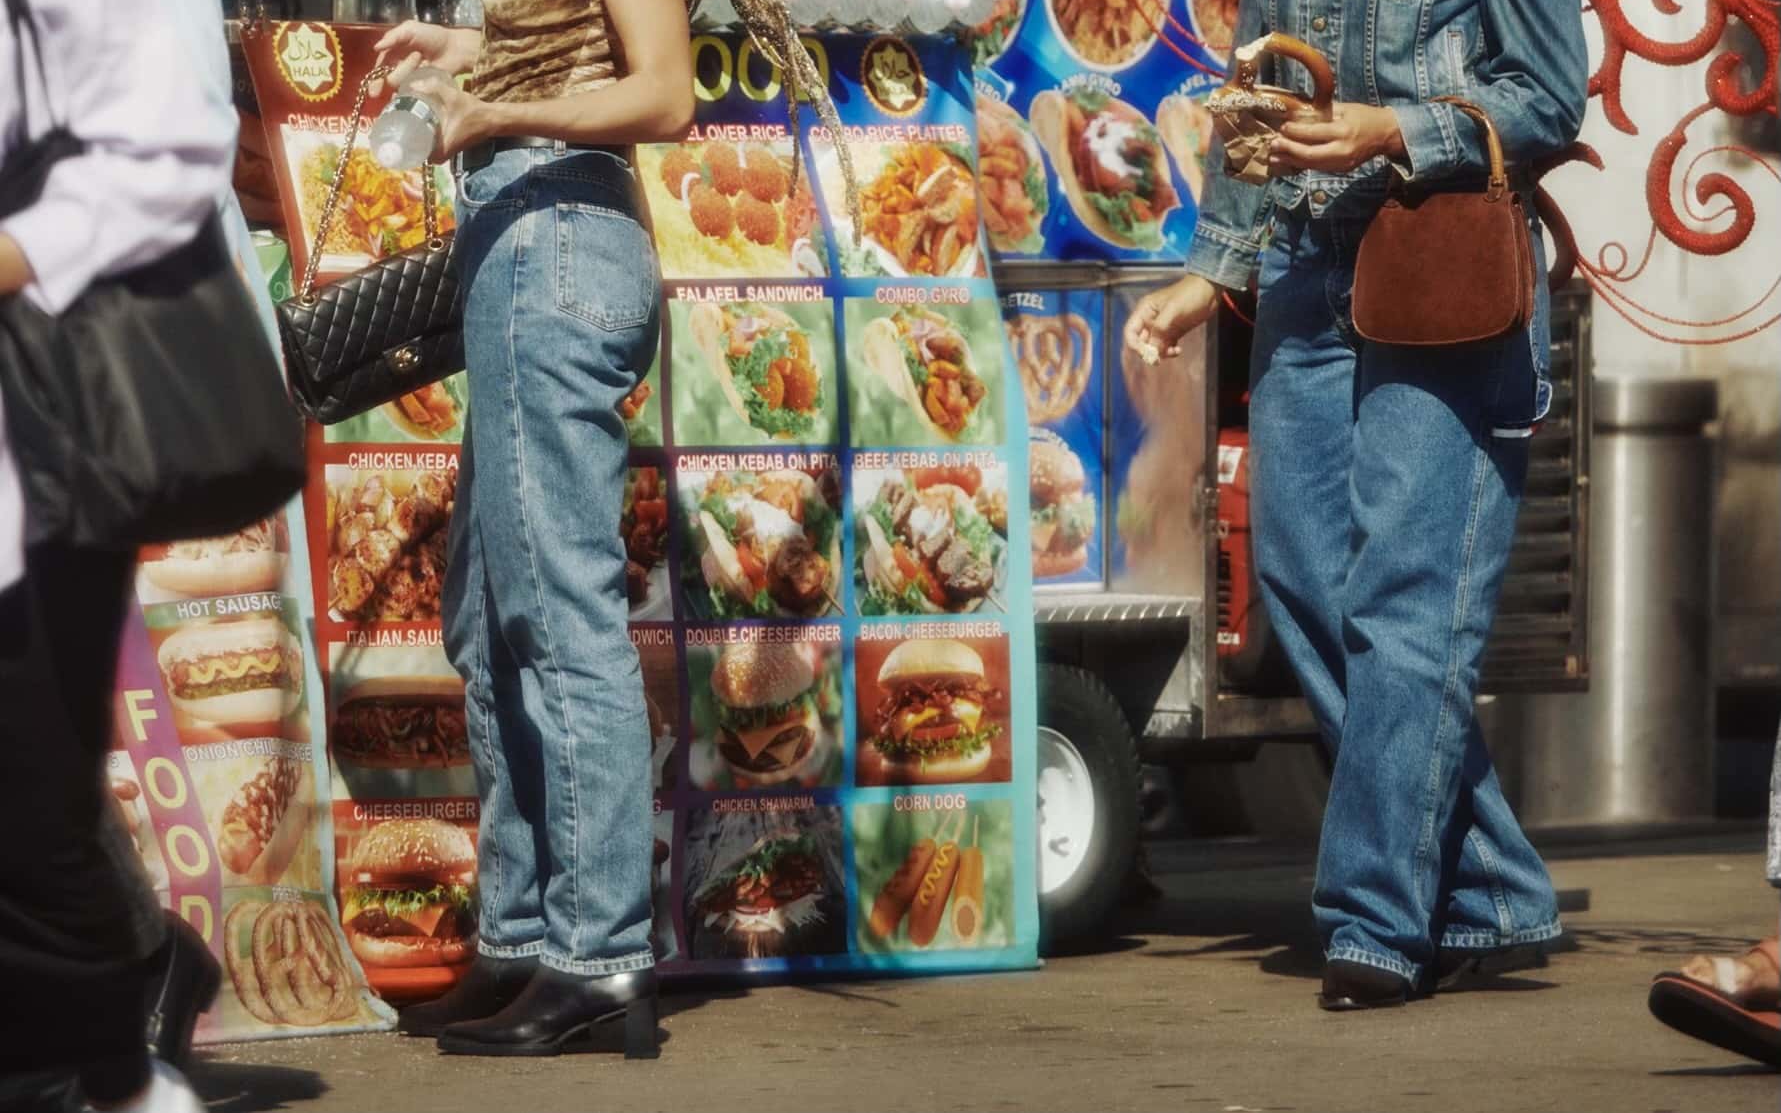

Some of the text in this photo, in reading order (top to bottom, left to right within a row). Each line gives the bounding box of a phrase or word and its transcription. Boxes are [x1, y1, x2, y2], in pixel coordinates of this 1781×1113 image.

[288, 114, 352, 134] CHICKEN
[706, 125, 747, 141] OVER
[751, 125, 785, 141] RICE
[810, 125, 967, 143] COBO RICE PLATTER
[676, 286, 824, 303] FALAFEL SANDWICH
[875, 288, 970, 304] COMBO GYRO
[999, 291, 1045, 311] RETZEL
[348, 453, 460, 470] CHICKEN KEBA
[678, 453, 838, 471] CHICKEN KEBAB ON PITA
[855, 451, 997, 470] BEEF KEBAB ON PITA
[177, 593, 282, 619] HOT SAUSAG
[346, 629, 402, 646] ITALIAN
[631, 628, 674, 646] DWICH
[686, 624, 841, 645] DOUBLE CHEESEBURGER
[860, 622, 1002, 641] BACON CHEESEBURGER
[185, 743, 240, 761] ONION
[354, 802, 477, 822] CHEESEBURGER
[712, 797, 816, 814] CHICKEN SHAWARMA
[893, 794, 967, 812] CORN DOG
